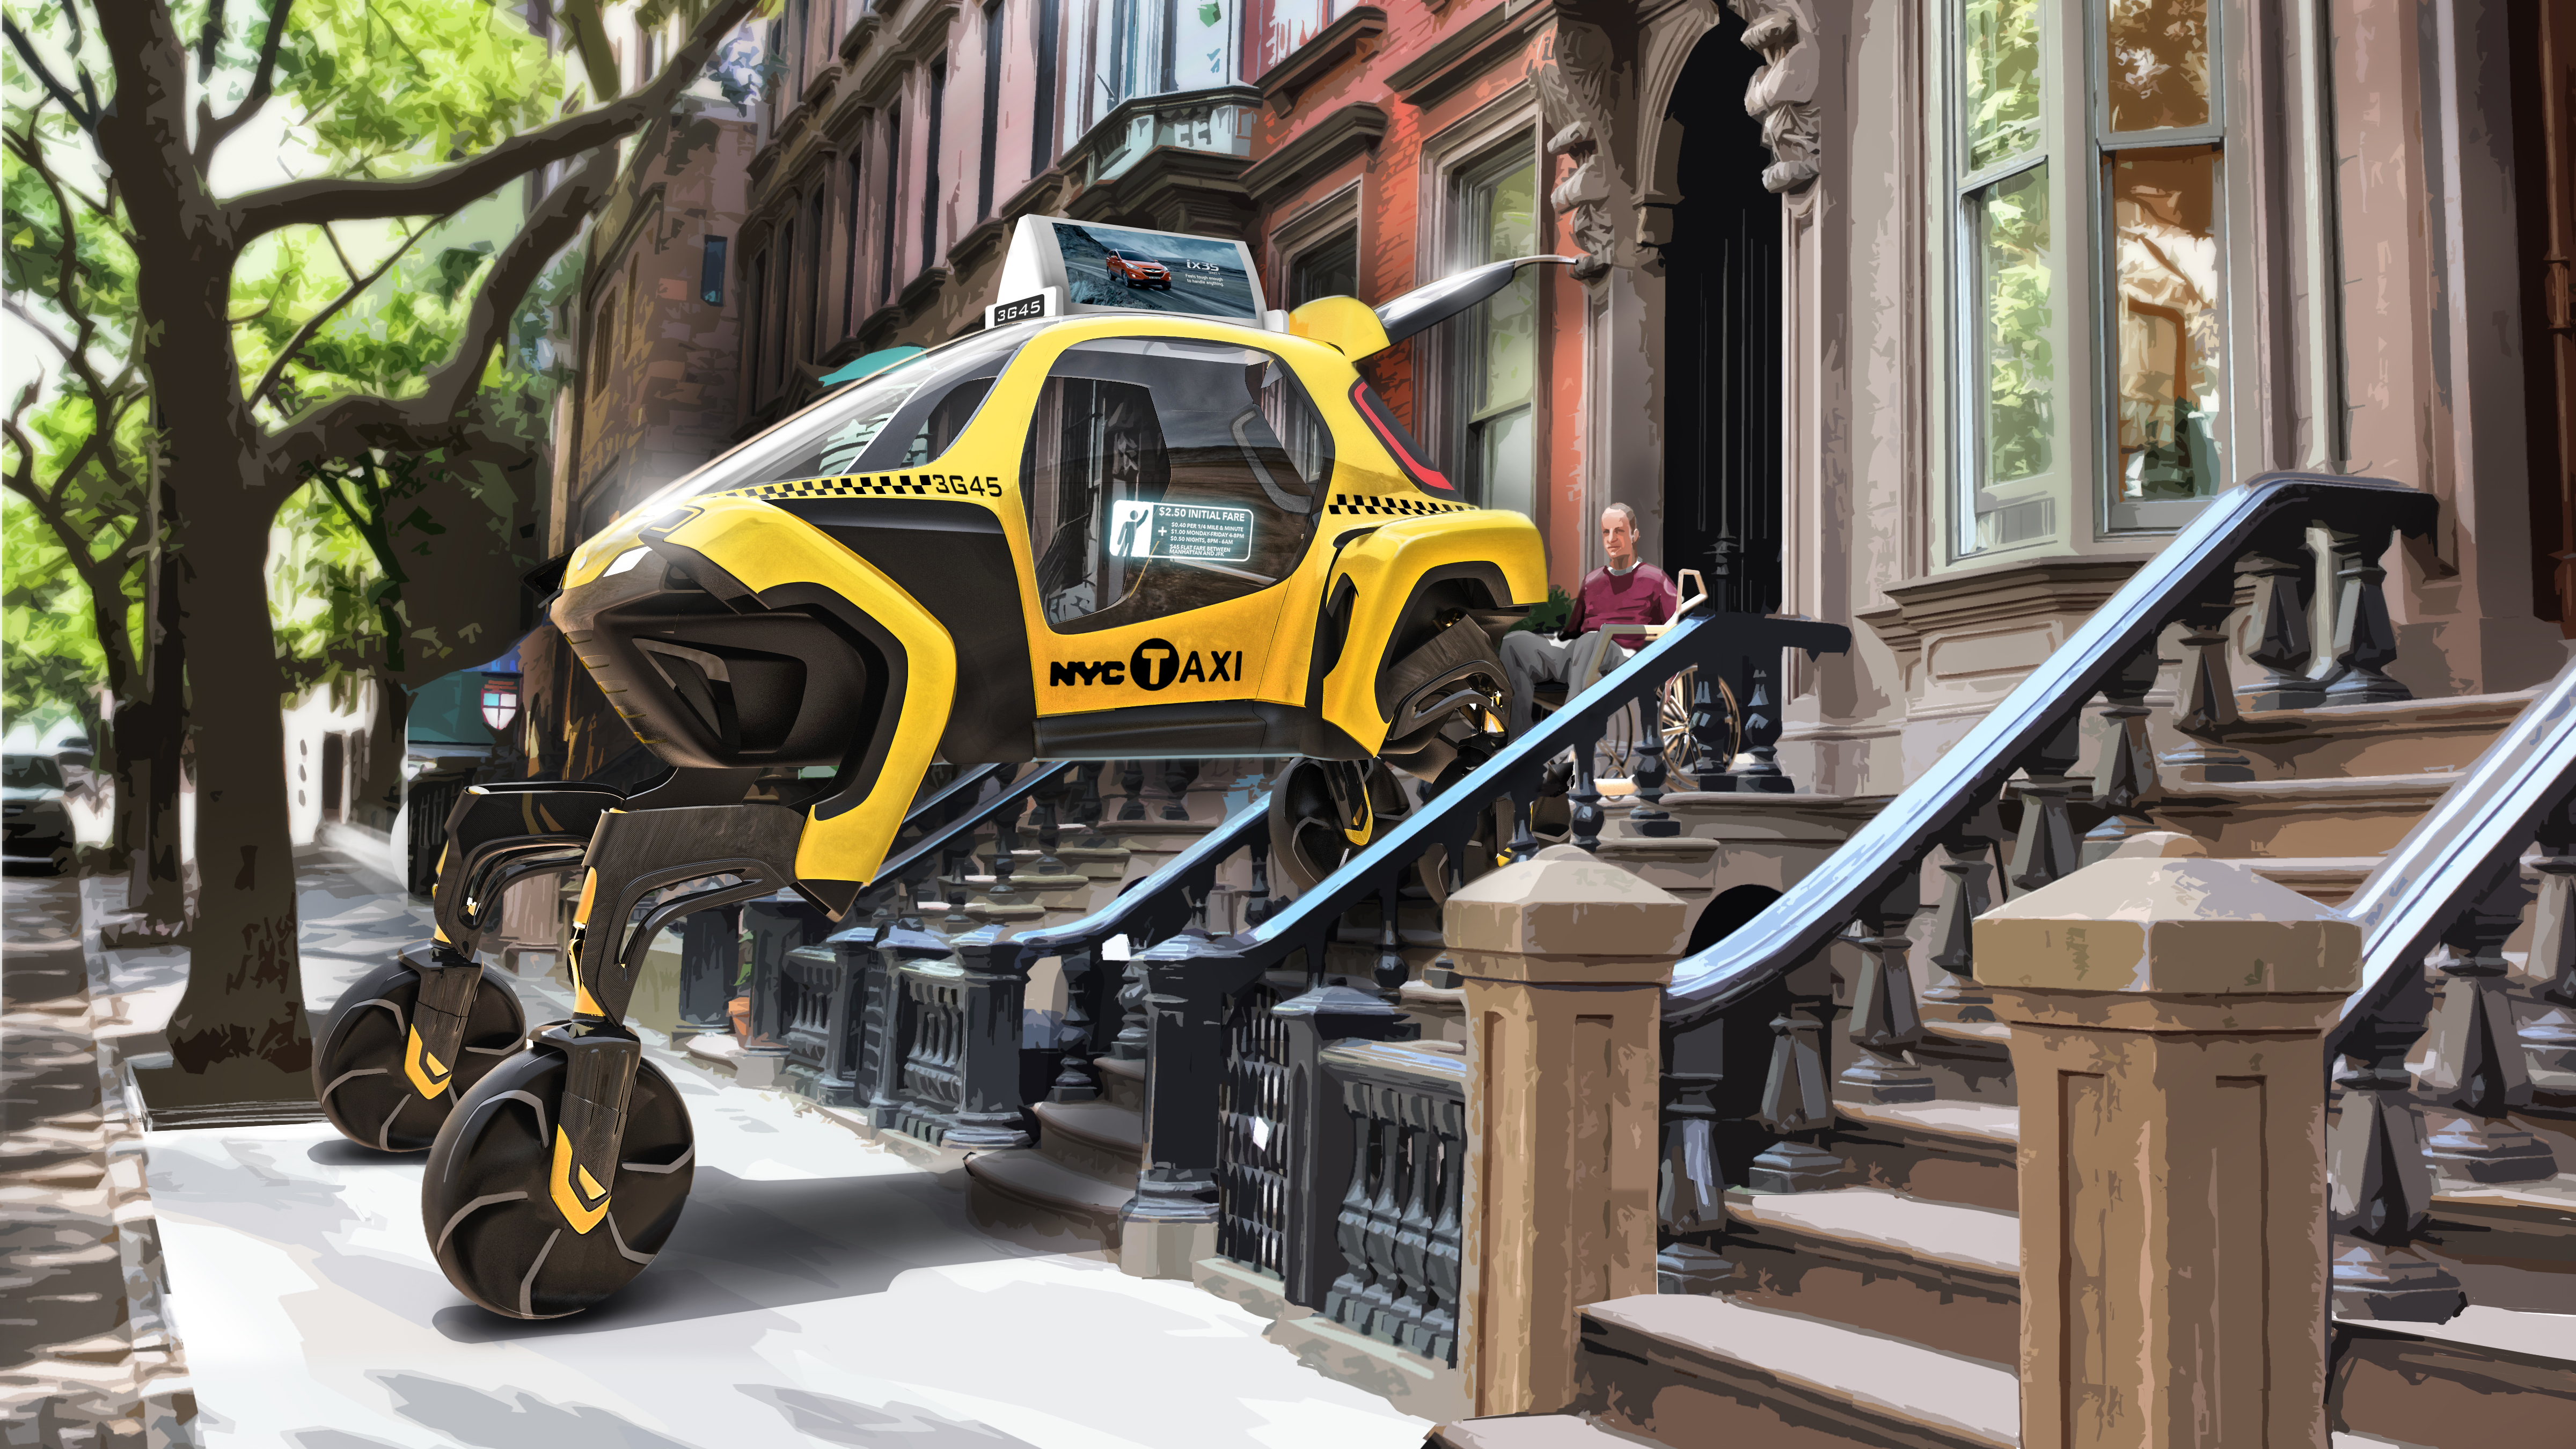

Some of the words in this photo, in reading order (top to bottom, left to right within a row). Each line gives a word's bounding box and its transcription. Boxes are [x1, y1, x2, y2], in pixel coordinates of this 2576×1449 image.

[1187, 259, 1219, 271] ix35
[998, 301, 1040, 321] 3G45
[932, 474, 1002, 497] 3G45
[1159, 507, 1186, 517] $2.50
[1188, 509, 1220, 520] INITIAL
[1223, 511, 1245, 522] FARE
[1050, 661, 1125, 686] NYC
[1130, 638, 1242, 691] TAXI
